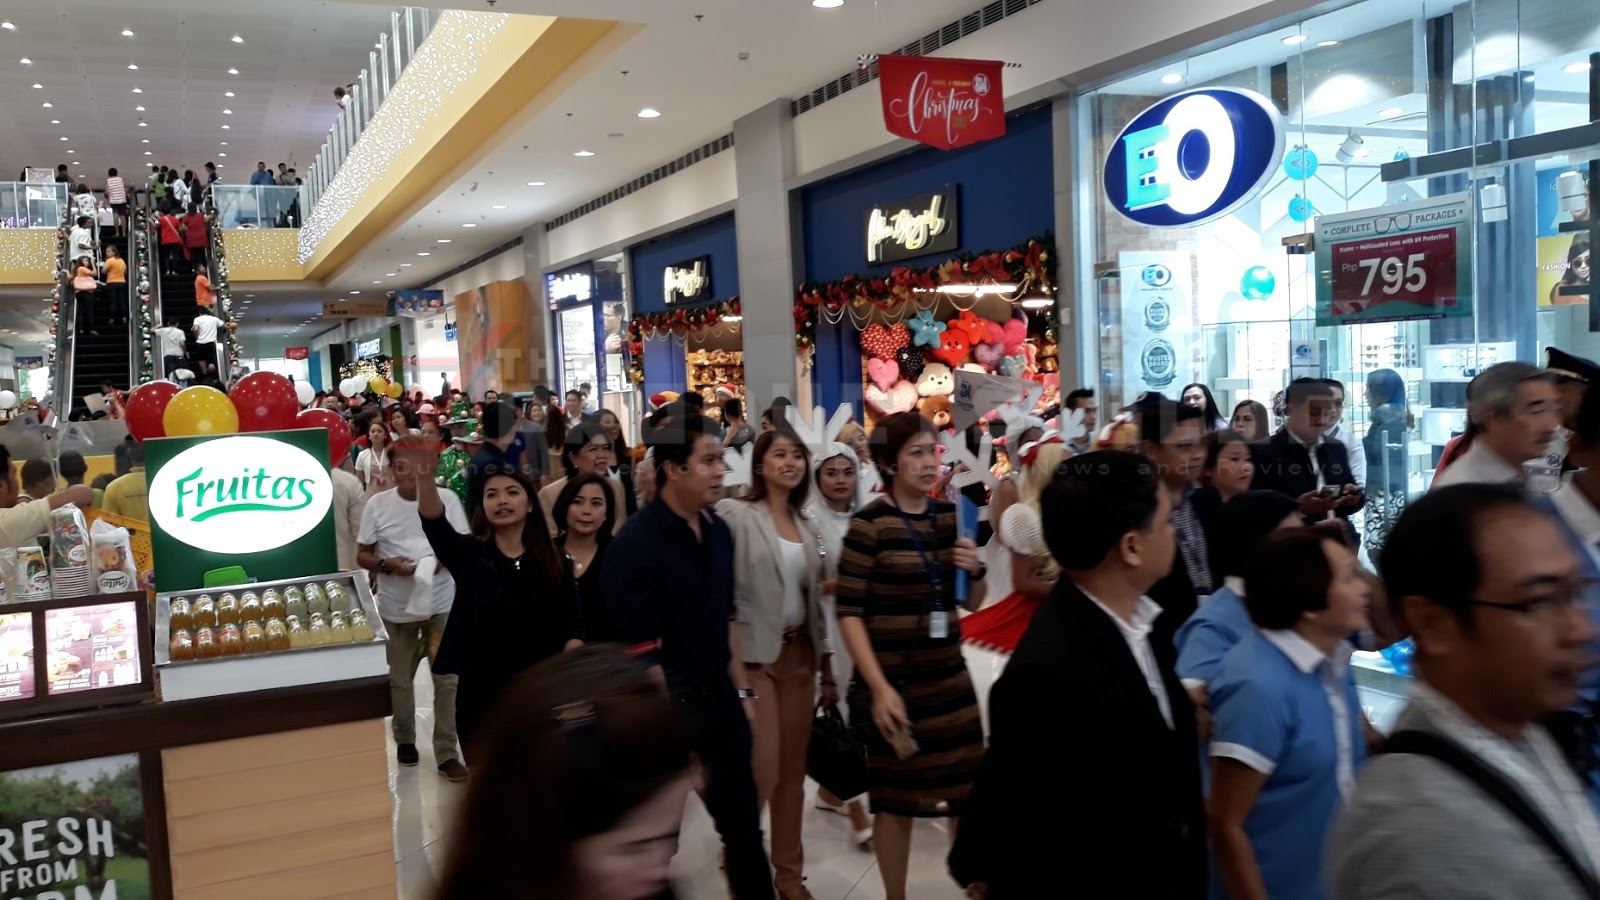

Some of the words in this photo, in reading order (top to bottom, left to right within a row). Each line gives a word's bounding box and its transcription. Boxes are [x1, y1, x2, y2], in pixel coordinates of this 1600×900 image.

[890, 72, 992, 144] Christmas
[1123, 94, 1236, 215] EO
[1331, 222, 1371, 236] COMPLETE
[1415, 209, 1457, 223] PACKAGES
[1389, 239, 1401, 247] Lens
[1402, 237, 1414, 245] with
[1423, 232, 1450, 243] Protection
[1342, 263, 1358, 273] Php
[1359, 253, 1427, 297] 795
[1542, 262, 1571, 271] FASHION
[176, 466, 315, 519] Fruitas
[0, 816, 115, 866] RESH
[0, 857, 78, 893] FROM
